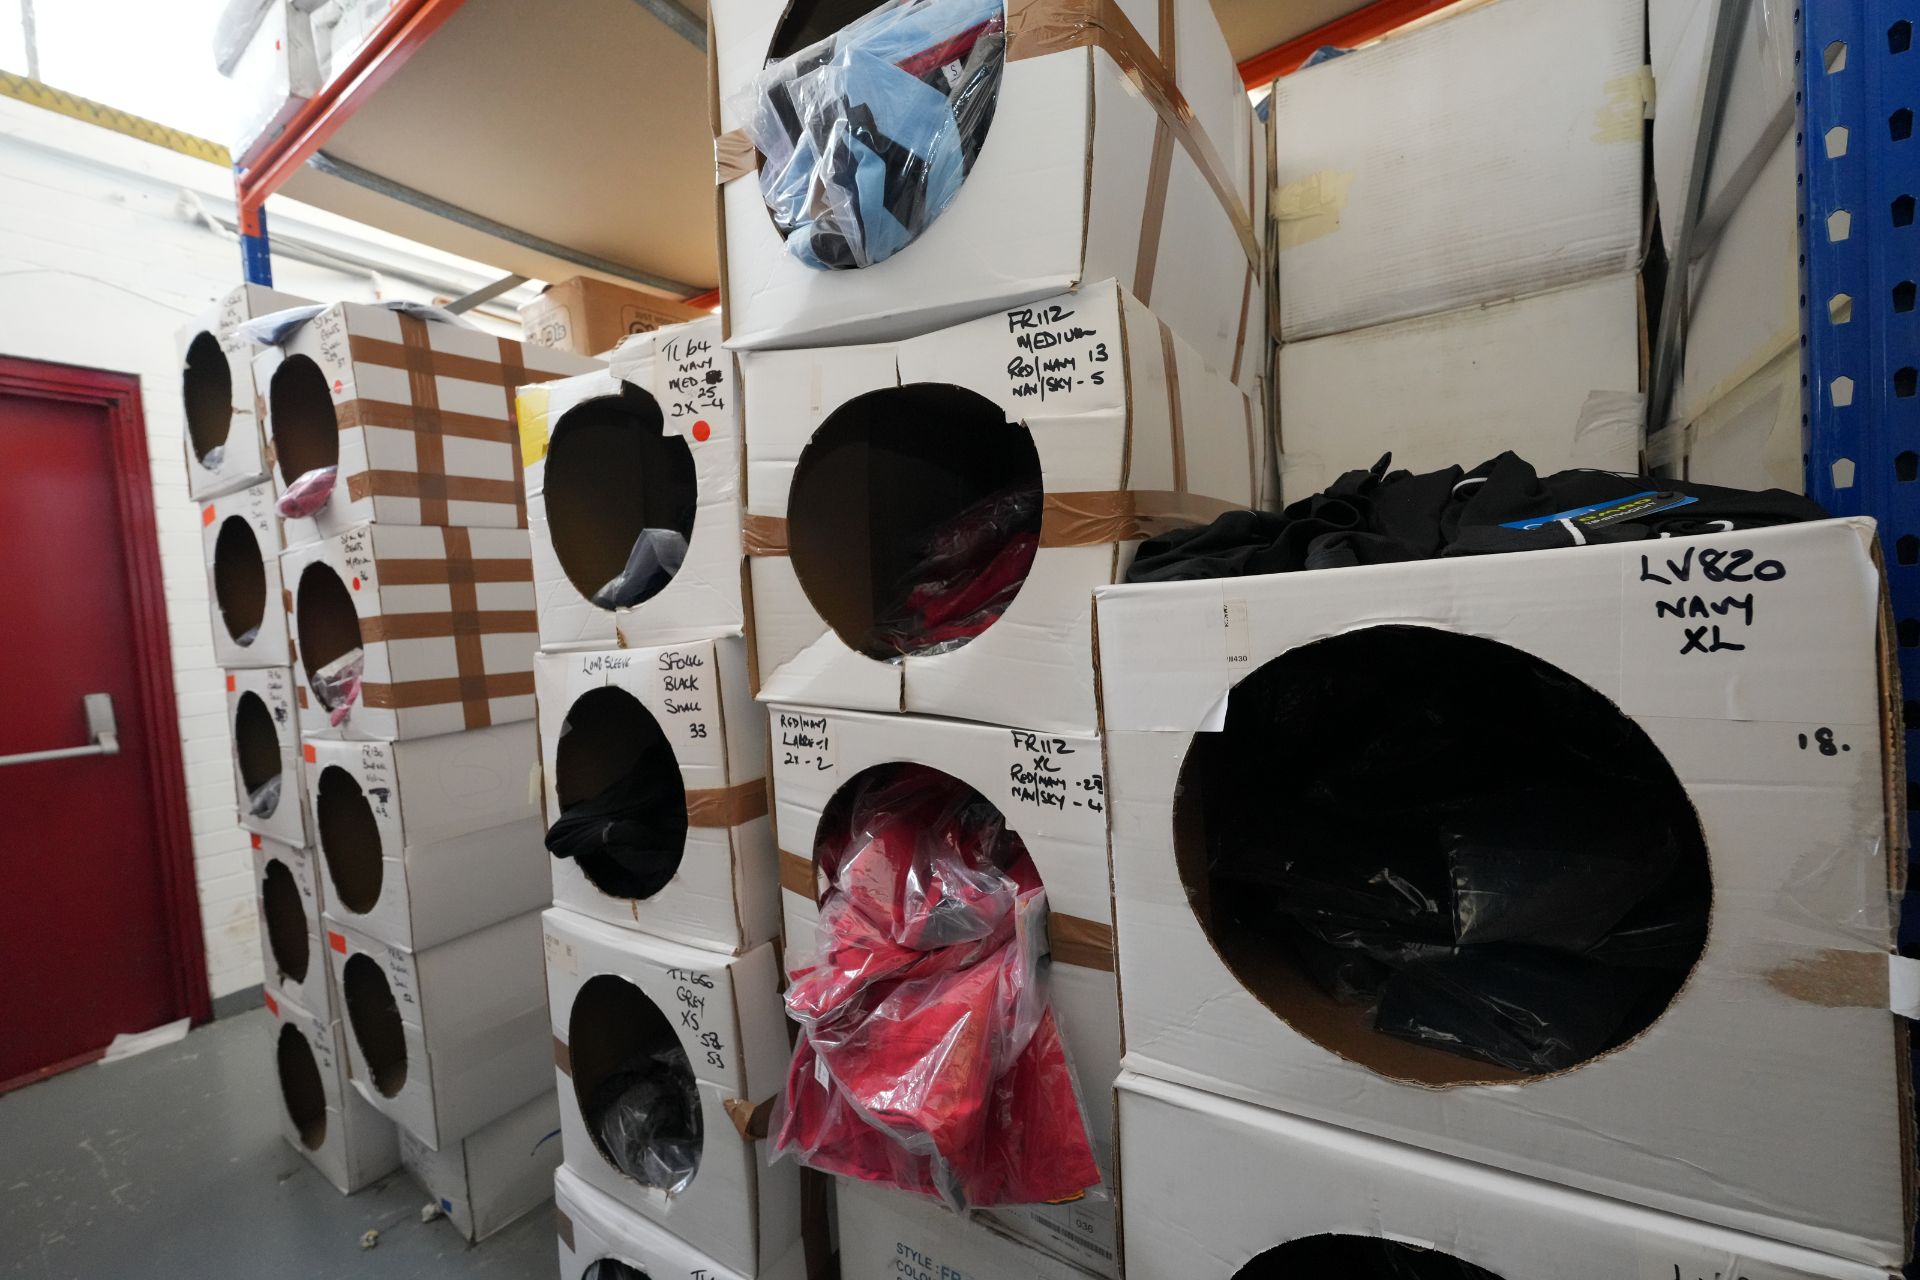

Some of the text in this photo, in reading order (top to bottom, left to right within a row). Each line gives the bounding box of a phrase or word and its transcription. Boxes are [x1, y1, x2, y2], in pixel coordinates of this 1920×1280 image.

[1008, 306, 1075, 333] FR112
[1017, 327, 1096, 353] MEDIUM
[679, 357, 712, 373] NAVY
[698, 386, 717, 398] 25
[1640, 547, 1786, 585] LV820
[1656, 593, 1753, 626] NAVY
[1680, 625, 1745, 654] XL
[664, 675, 699, 691] BLACK
[690, 723, 707, 738] 33
[1011, 729, 1075, 754] FR112
[677, 986, 704, 1019] GREY
[896, 1242, 932, 1270] STYLE
